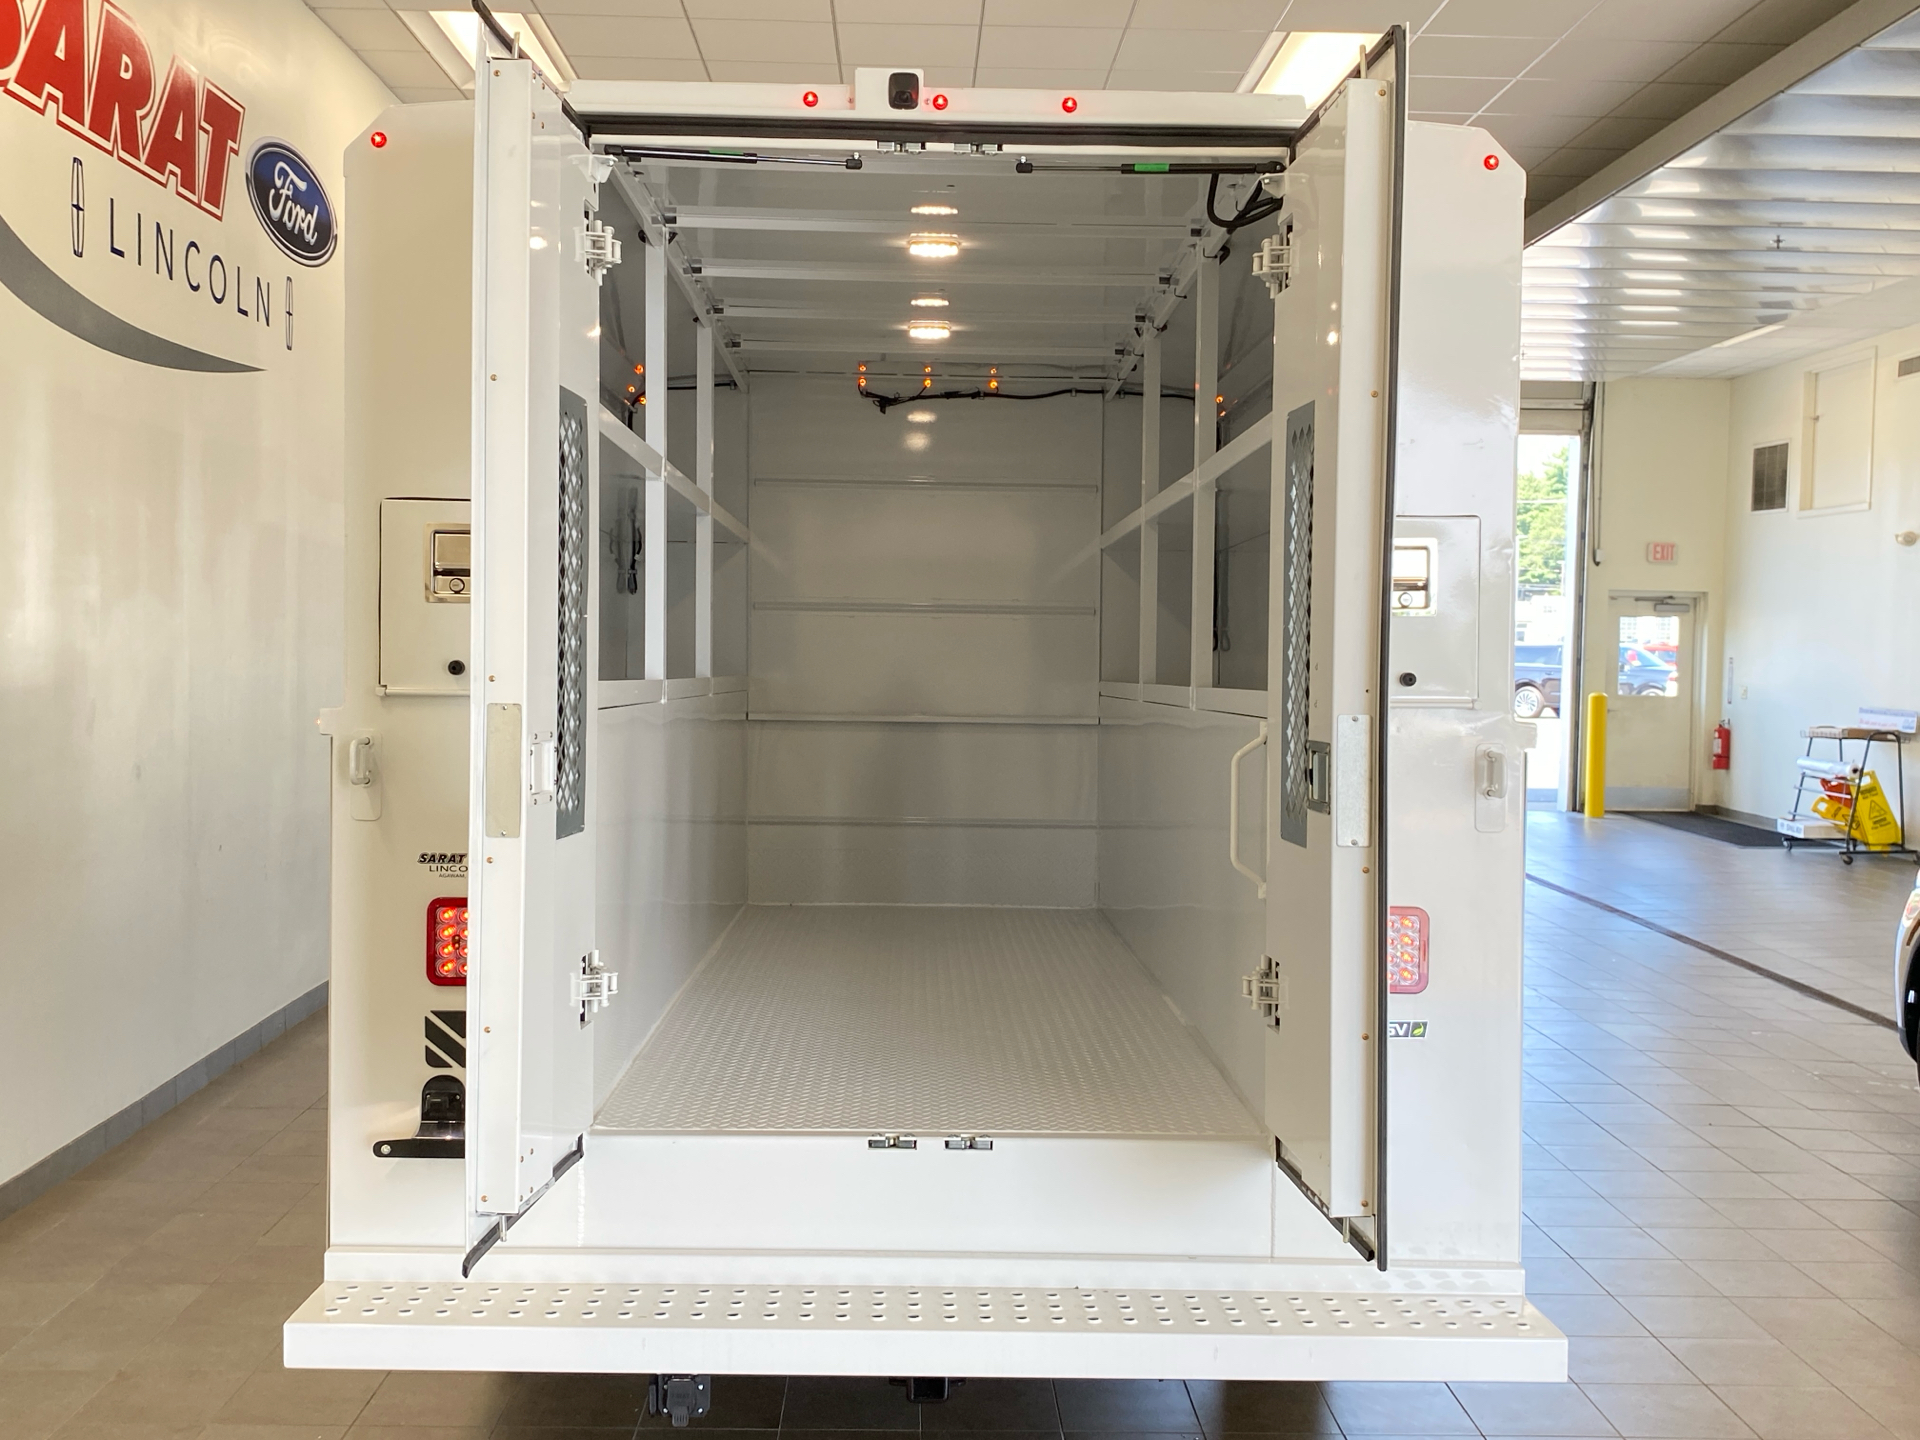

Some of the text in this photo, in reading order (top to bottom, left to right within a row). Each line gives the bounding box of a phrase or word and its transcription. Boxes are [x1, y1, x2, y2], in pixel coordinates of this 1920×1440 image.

[268, 160, 320, 247] Ford
[109, 197, 270, 328] LINCOLN
[1652, 542, 1676, 561] EXIT
[417, 852, 468, 864] SARAT
